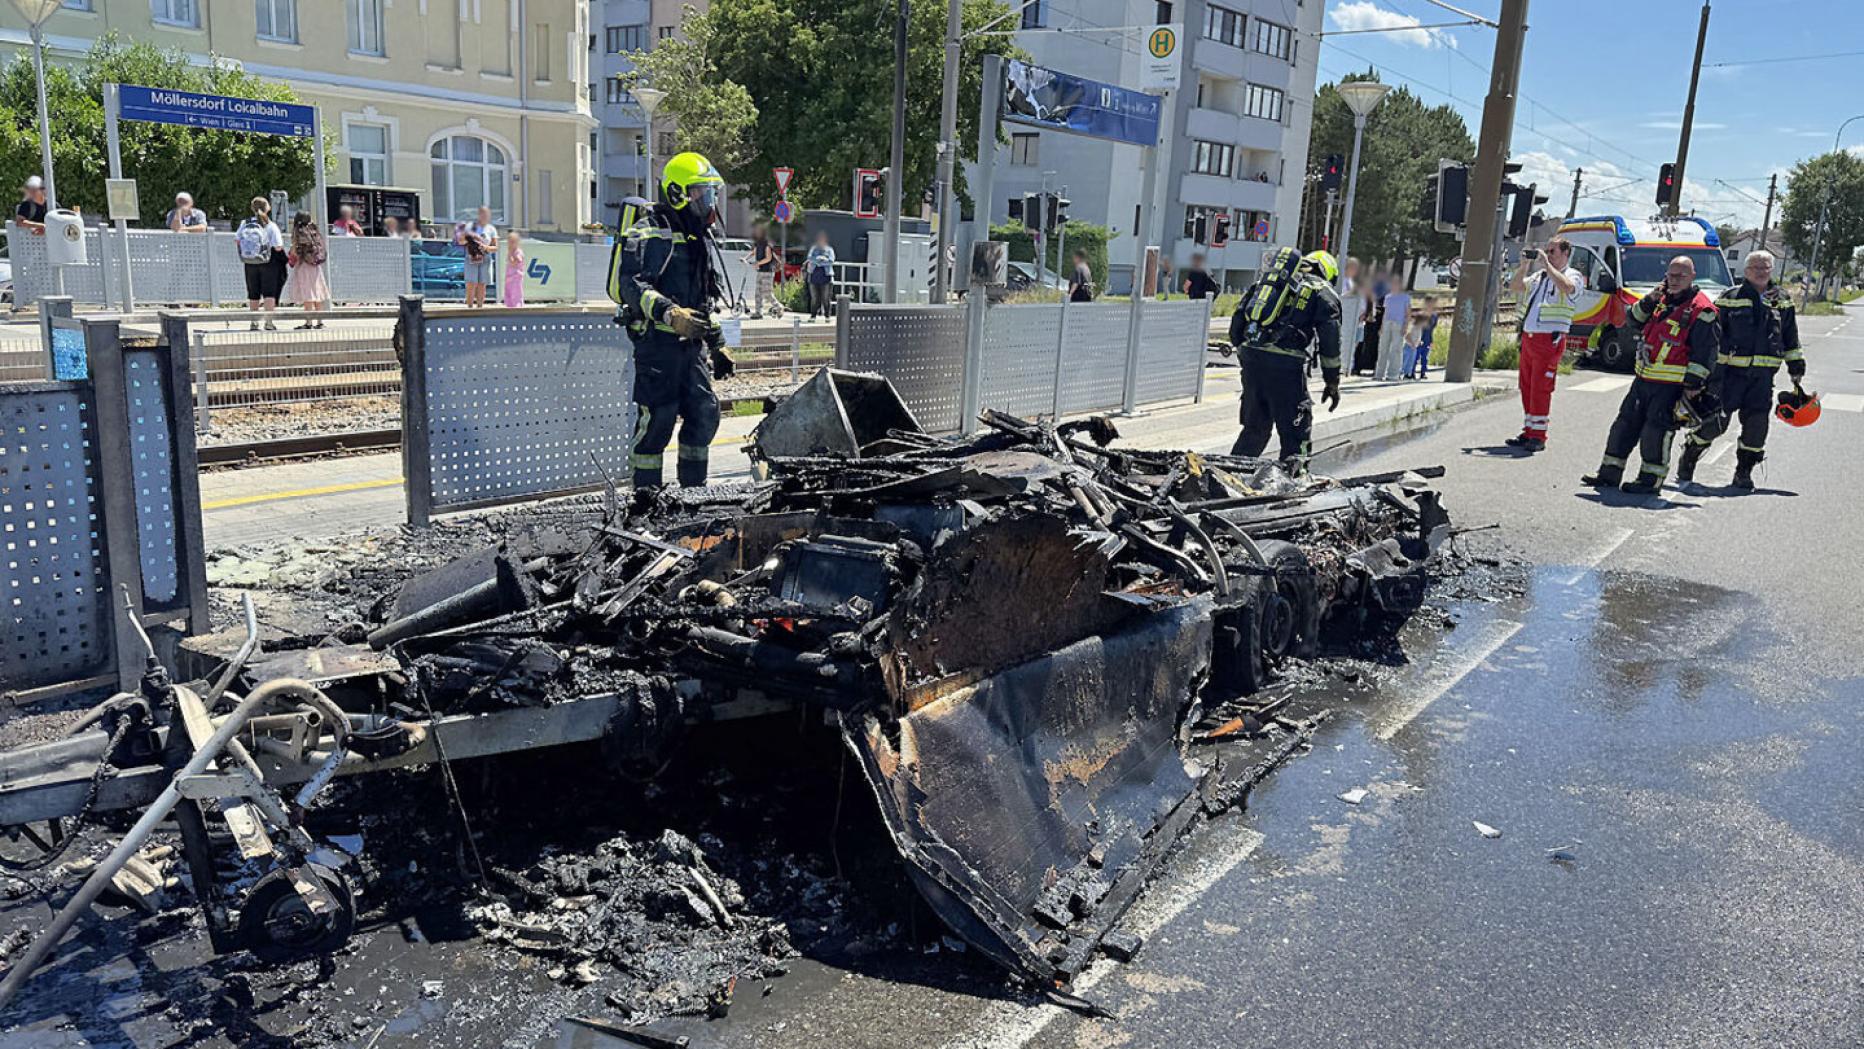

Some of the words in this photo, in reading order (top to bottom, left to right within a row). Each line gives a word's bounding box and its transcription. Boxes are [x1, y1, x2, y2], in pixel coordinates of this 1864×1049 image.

[1155, 33, 1169, 52] H
[151, 91, 225, 110] Möllersdorf
[228, 101, 288, 118] Lokalbahn
